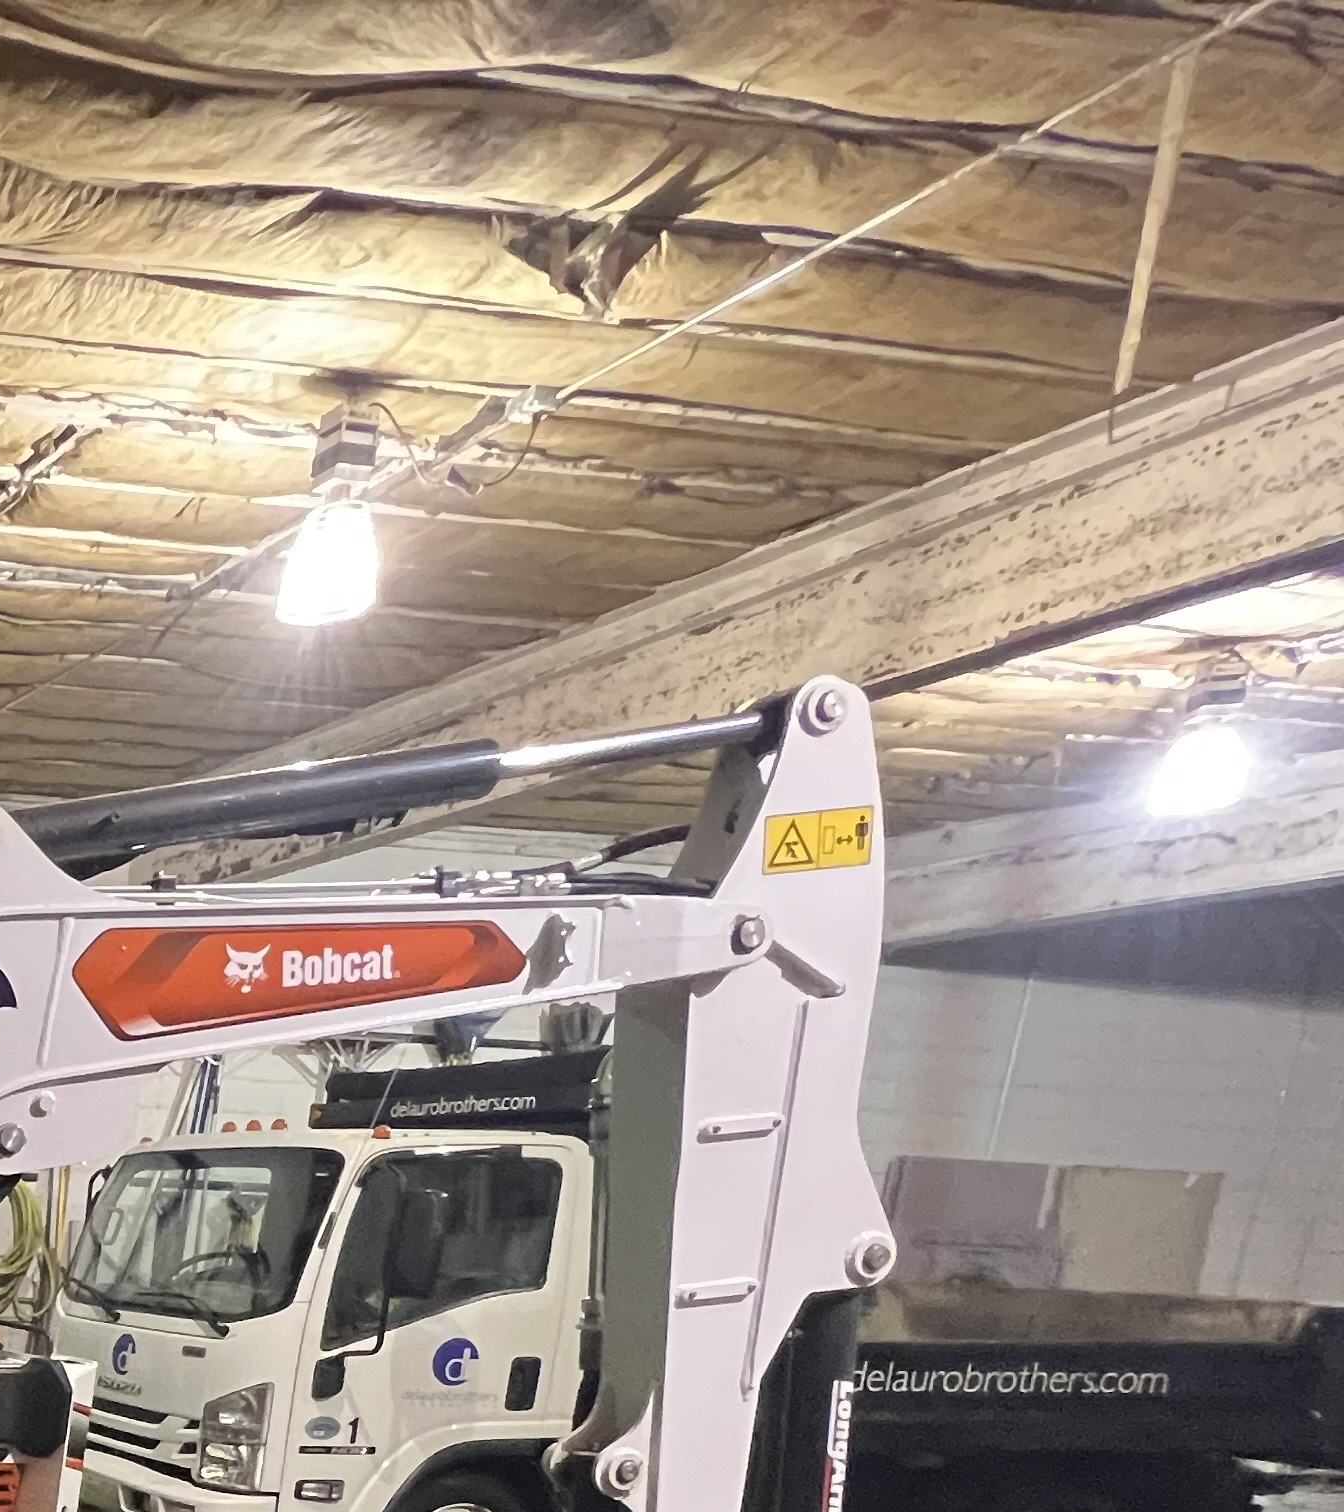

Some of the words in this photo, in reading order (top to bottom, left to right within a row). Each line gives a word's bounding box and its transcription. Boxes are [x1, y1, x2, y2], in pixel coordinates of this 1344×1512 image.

[281, 944, 395, 989] Bobcat
[389, 1094, 536, 1119] delaurobrothers.com
[851, 1360, 1170, 1395] delaurobrothers.com
[348, 1417, 360, 1444] 1
